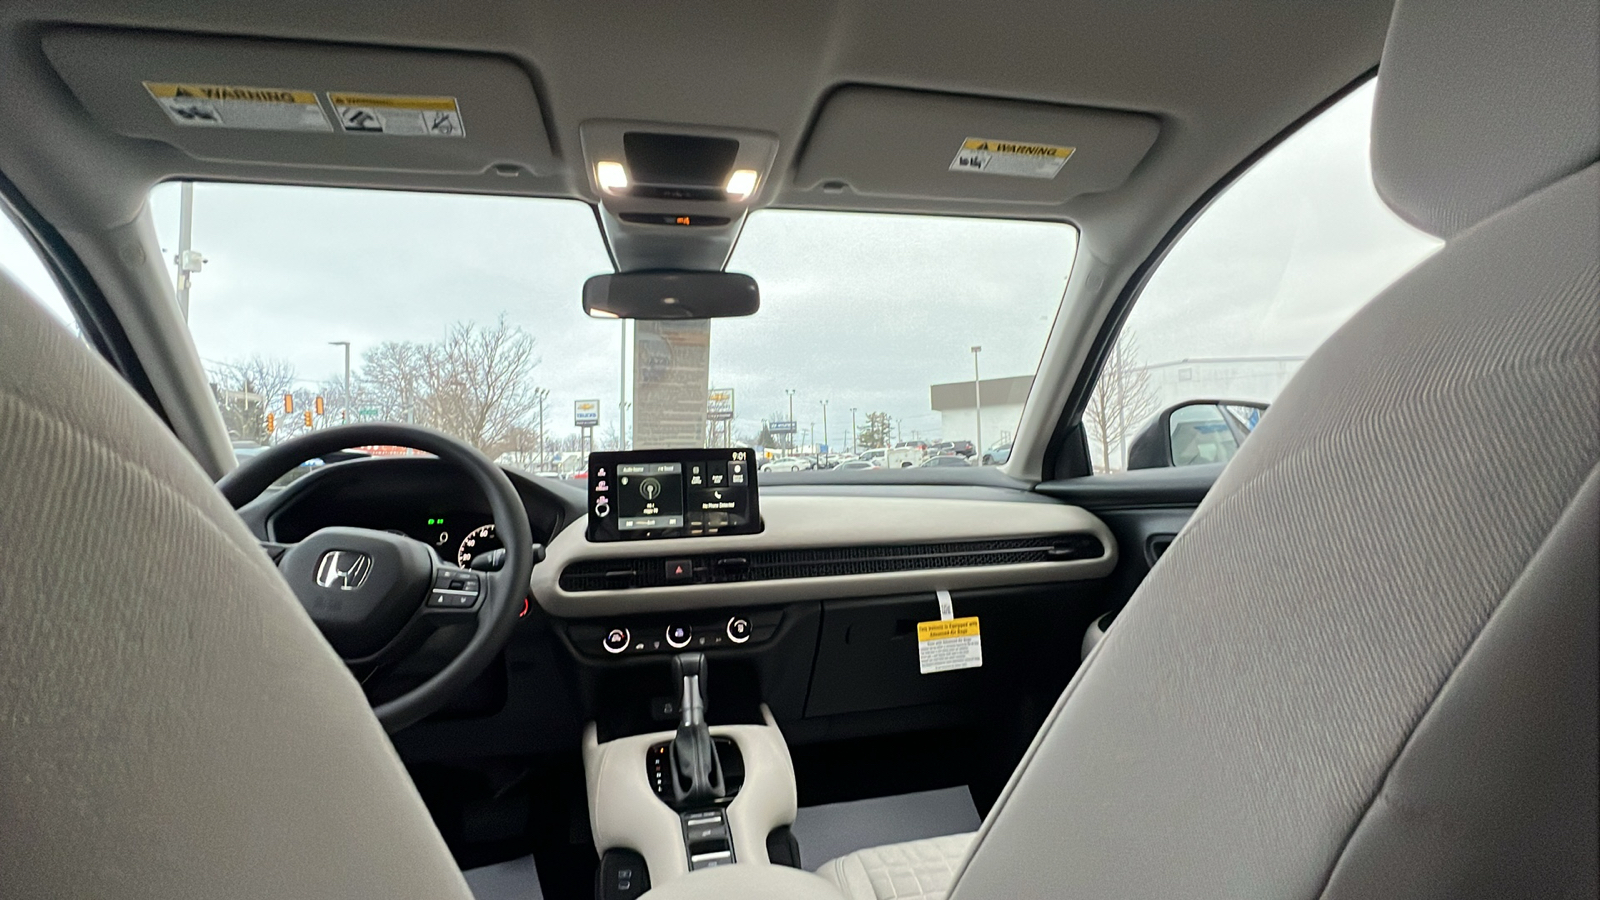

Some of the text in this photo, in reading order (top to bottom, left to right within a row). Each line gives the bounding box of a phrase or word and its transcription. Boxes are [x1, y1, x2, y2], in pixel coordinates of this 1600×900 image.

[202, 87, 295, 103] WARNING
[997, 143, 1058, 156] WARNING
[732, 451, 747, 461] 9:01
[480, 530, 488, 538] 60
